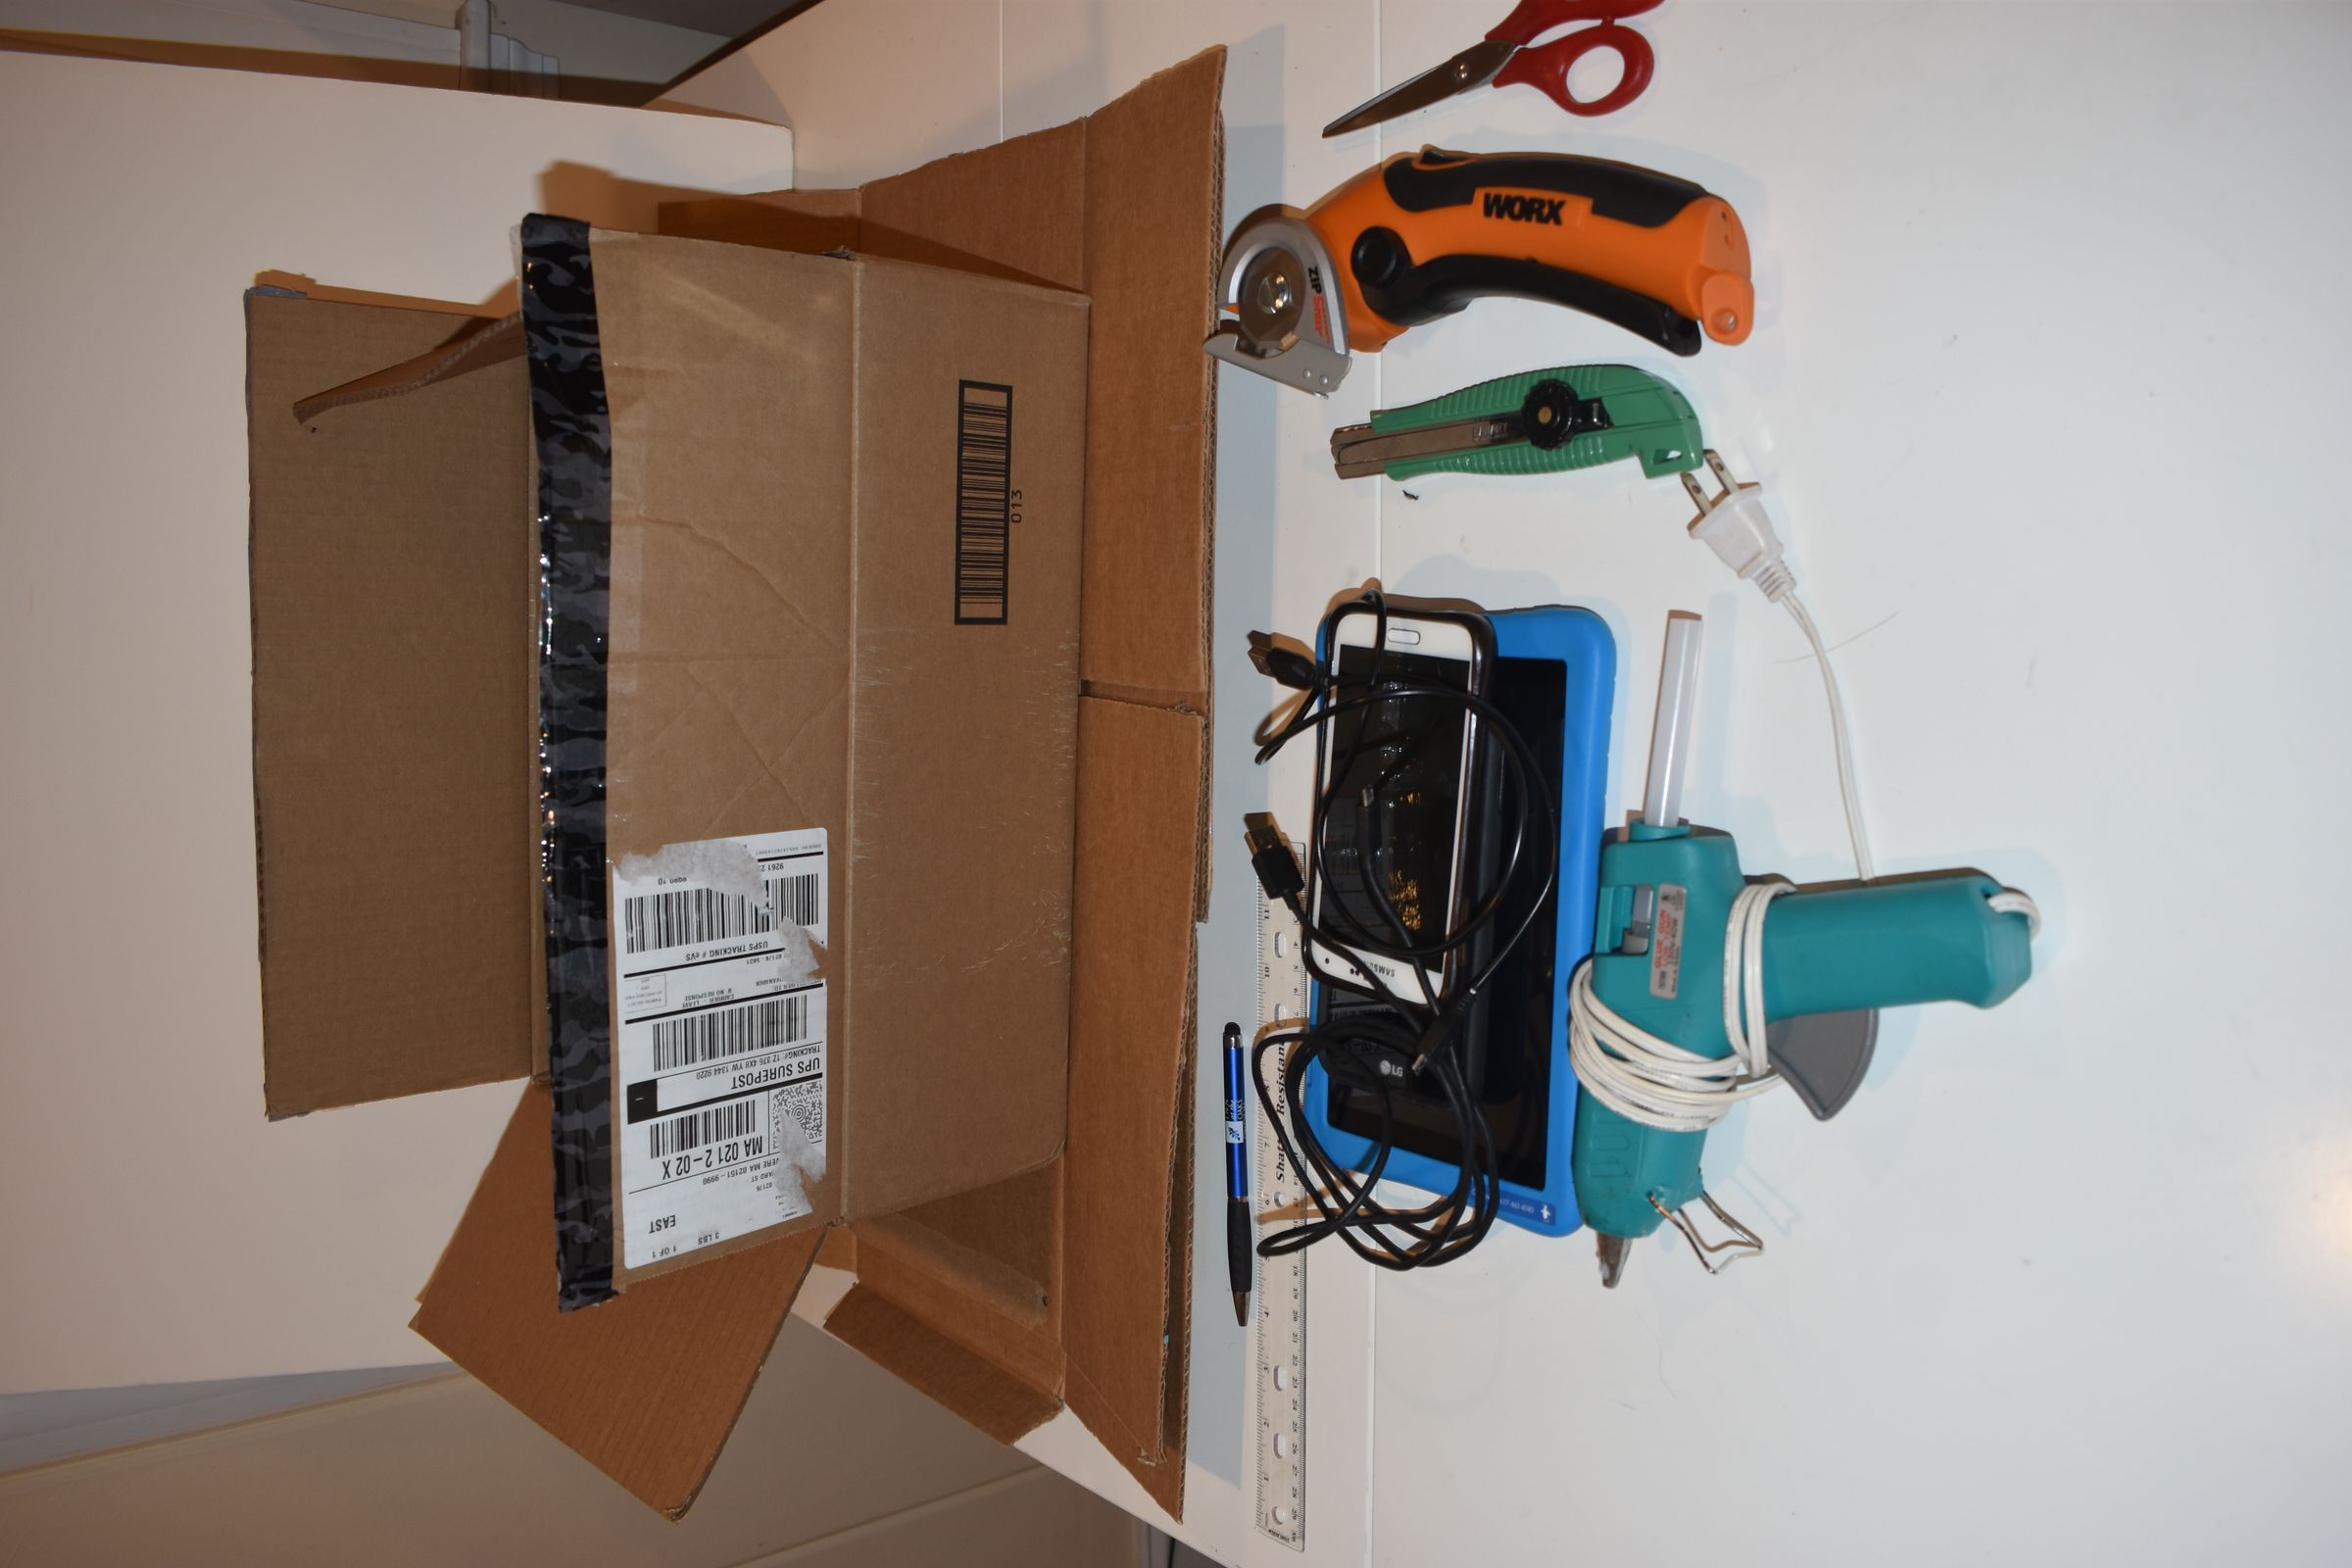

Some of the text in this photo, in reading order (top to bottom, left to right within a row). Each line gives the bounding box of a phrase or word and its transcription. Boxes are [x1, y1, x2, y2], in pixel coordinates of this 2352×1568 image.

[1484, 192, 1566, 226] WORX
[1010, 489, 1022, 524] 013
[767, 862, 784, 871] 9261
[710, 944, 746, 957] TRACKING
[749, 941, 768, 951] USPS
[731, 1061, 744, 1071] YW
[760, 1055, 771, 1064] 376
[713, 1064, 729, 1076] 1344
[731, 1057, 820, 1089] UPS SUREPOST
[1276, 1041, 1286, 1116] Resistan
[744, 1136, 762, 1154] MA
[717, 1142, 738, 1162] 021
[662, 1160, 671, 1180] X
[749, 1162, 760, 1173] MA
[649, 1215, 676, 1234] EAST
[698, 1234, 712, 1245] LBS
[659, 1247, 669, 1255] OF
